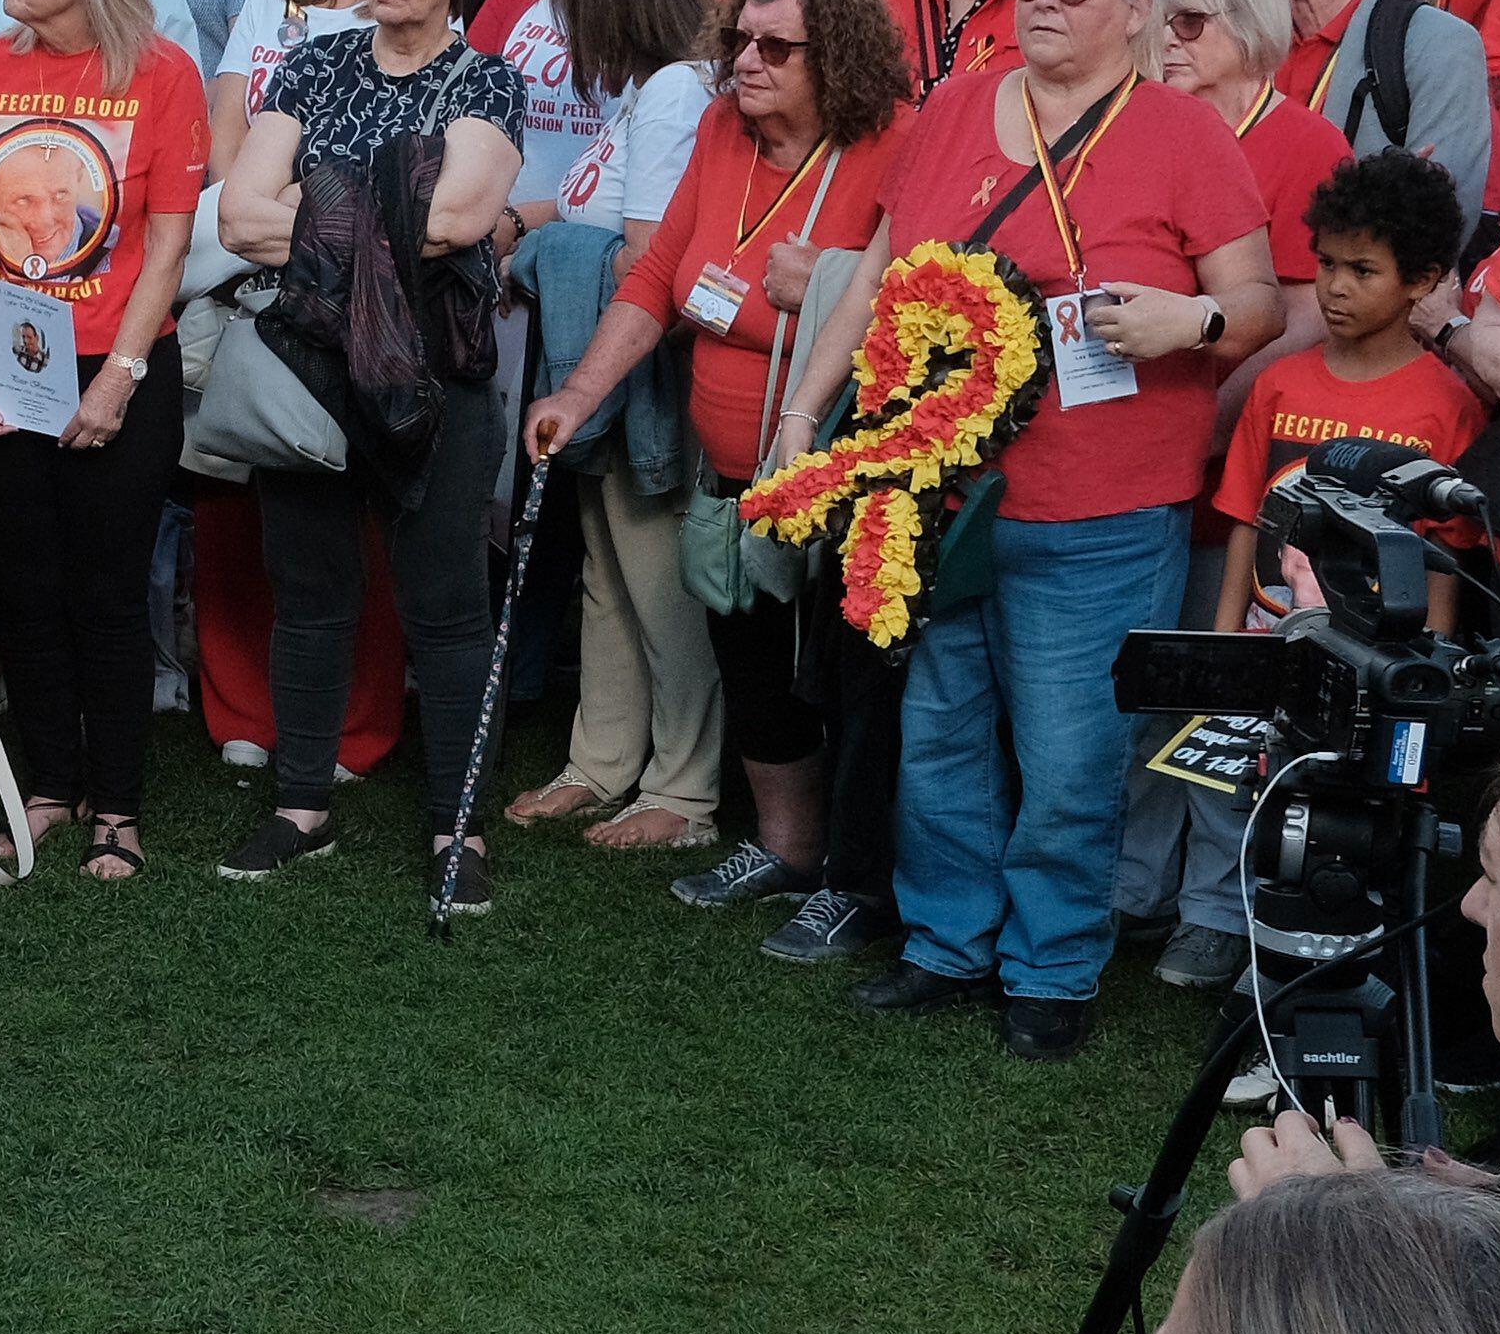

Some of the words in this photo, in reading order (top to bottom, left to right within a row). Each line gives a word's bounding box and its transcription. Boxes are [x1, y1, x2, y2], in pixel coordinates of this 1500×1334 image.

[73, 97, 141, 118] BLOOD
[531, 99, 557, 115] YOU
[1302, 1052, 1361, 1064] sachtler
